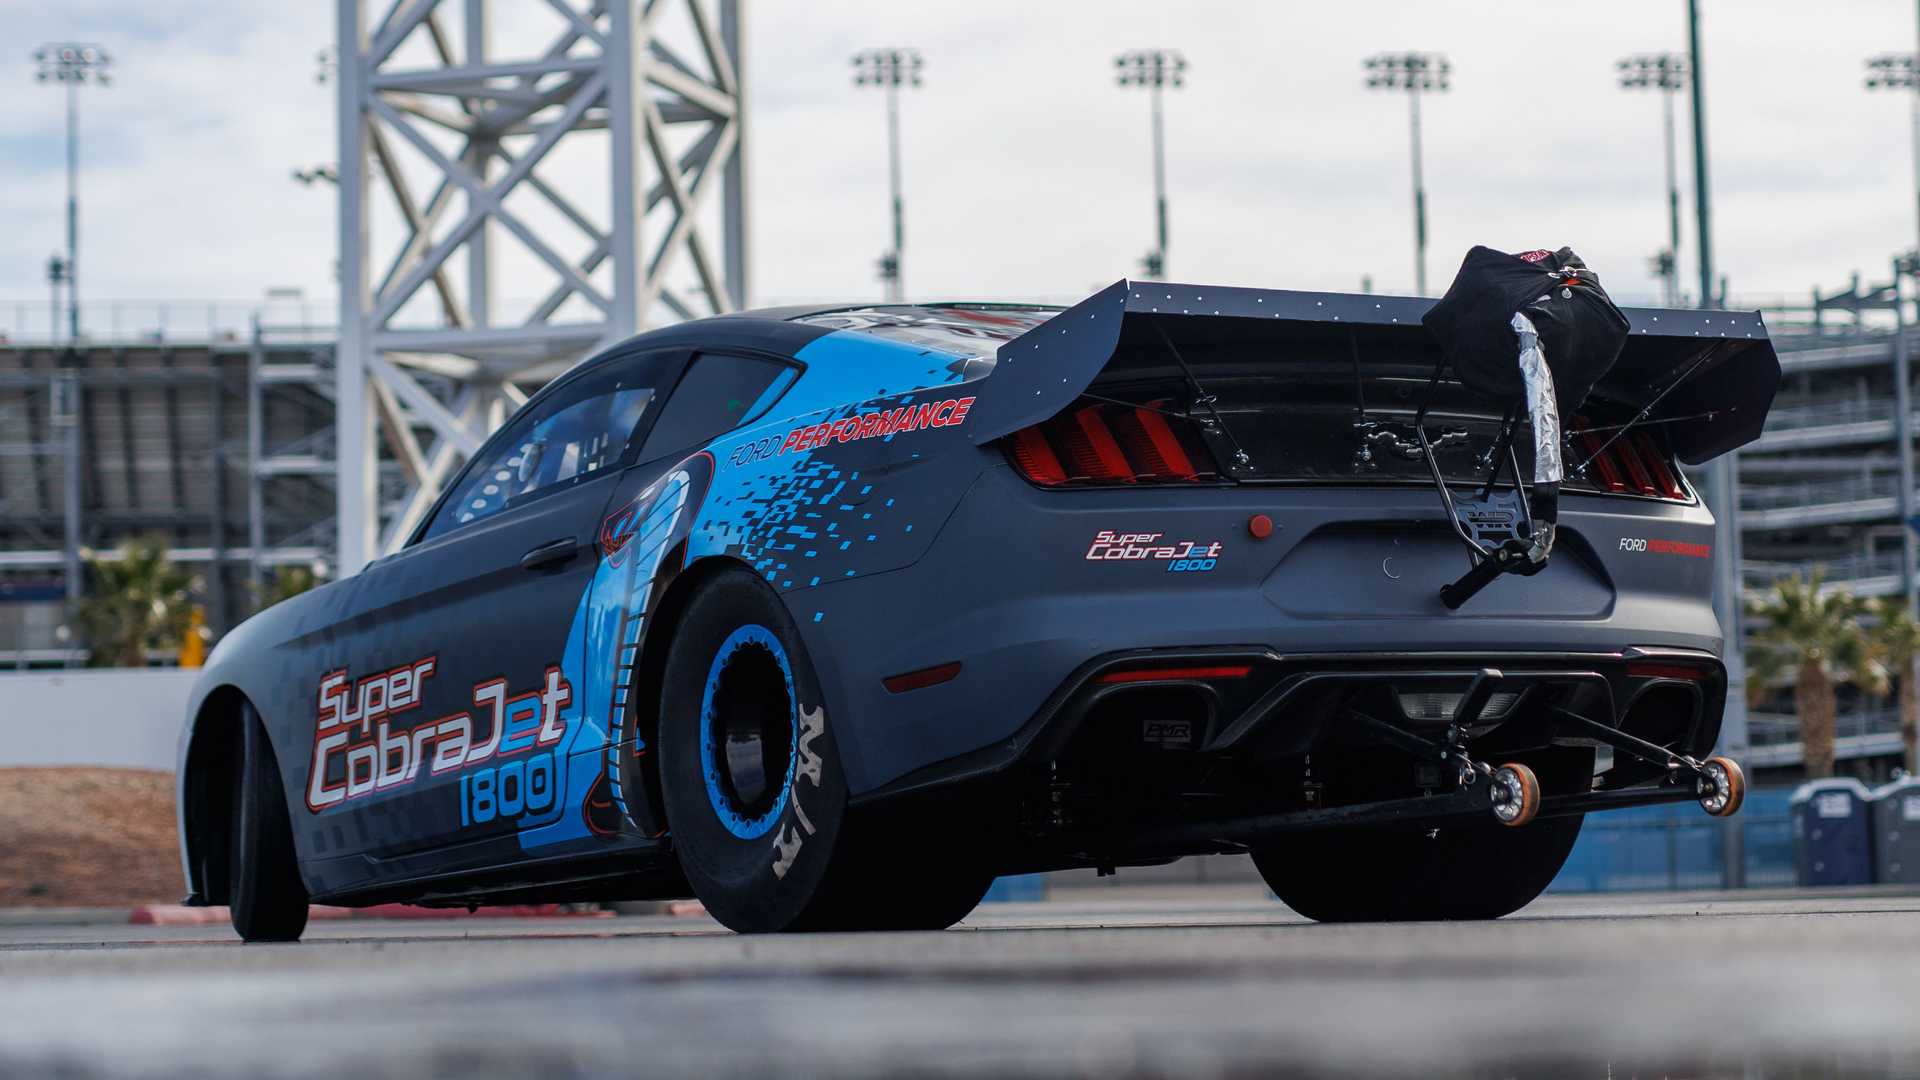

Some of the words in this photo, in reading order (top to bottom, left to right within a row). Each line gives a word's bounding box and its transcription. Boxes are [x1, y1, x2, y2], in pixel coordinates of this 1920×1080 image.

[722, 434, 782, 472] FORD
[779, 396, 977, 457] PERFORMANCE
[1094, 530, 1163, 546] Super
[1618, 537, 1647, 552] FORD
[1167, 558, 1217, 572] 1800
[317, 657, 436, 736] Super
[460, 751, 556, 828] 1800
